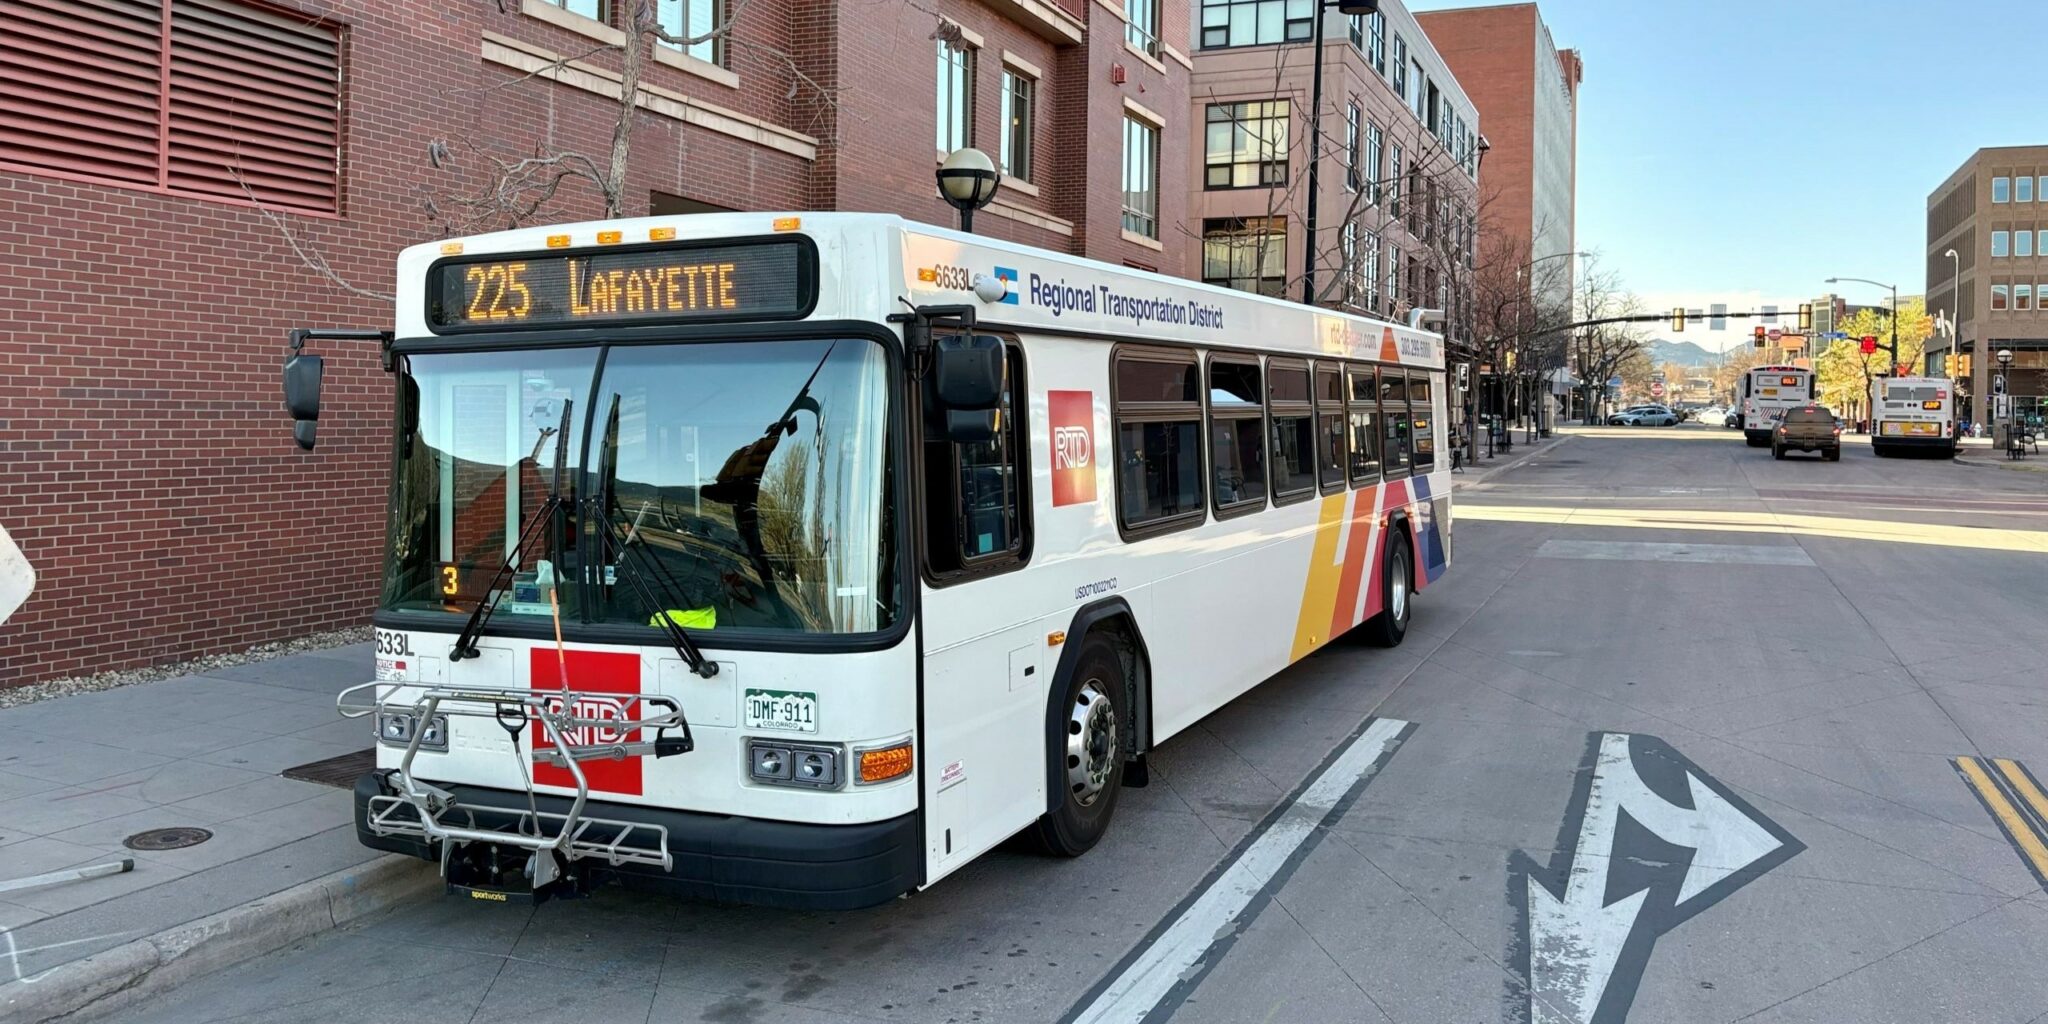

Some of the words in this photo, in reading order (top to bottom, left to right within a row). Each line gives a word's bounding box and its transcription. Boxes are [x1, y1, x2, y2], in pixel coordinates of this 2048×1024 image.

[467, 264, 531, 320] 225
[935, 263, 974, 291] 6633L
[1030, 273, 1096, 317] Regional
[1100, 285, 1187, 326] Transportation
[1188, 301, 1223, 329] District
[1054, 426, 1091, 470] RTD
[443, 566, 458, 595] 3
[763, 720, 798, 729] COLORADO
